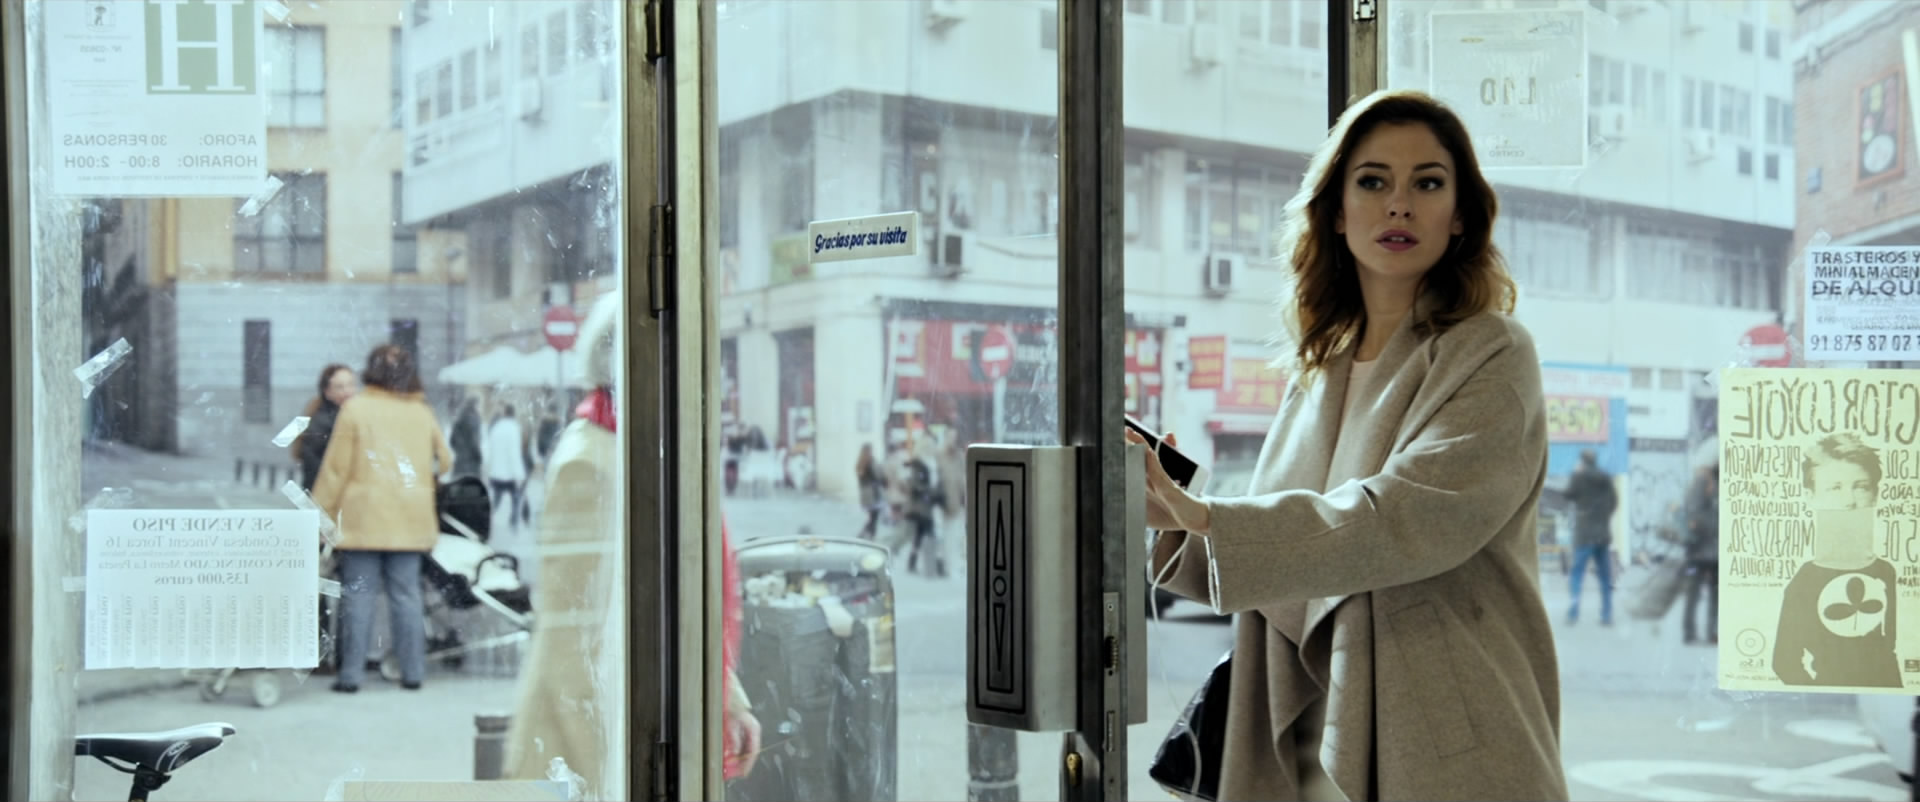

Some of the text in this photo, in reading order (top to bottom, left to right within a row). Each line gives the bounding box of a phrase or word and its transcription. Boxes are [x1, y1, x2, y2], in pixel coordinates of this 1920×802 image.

[814, 226, 908, 253] Gracias por su visita
[1811, 251, 1907, 264] TRASTEROS
[1812, 280, 1842, 296] DE
